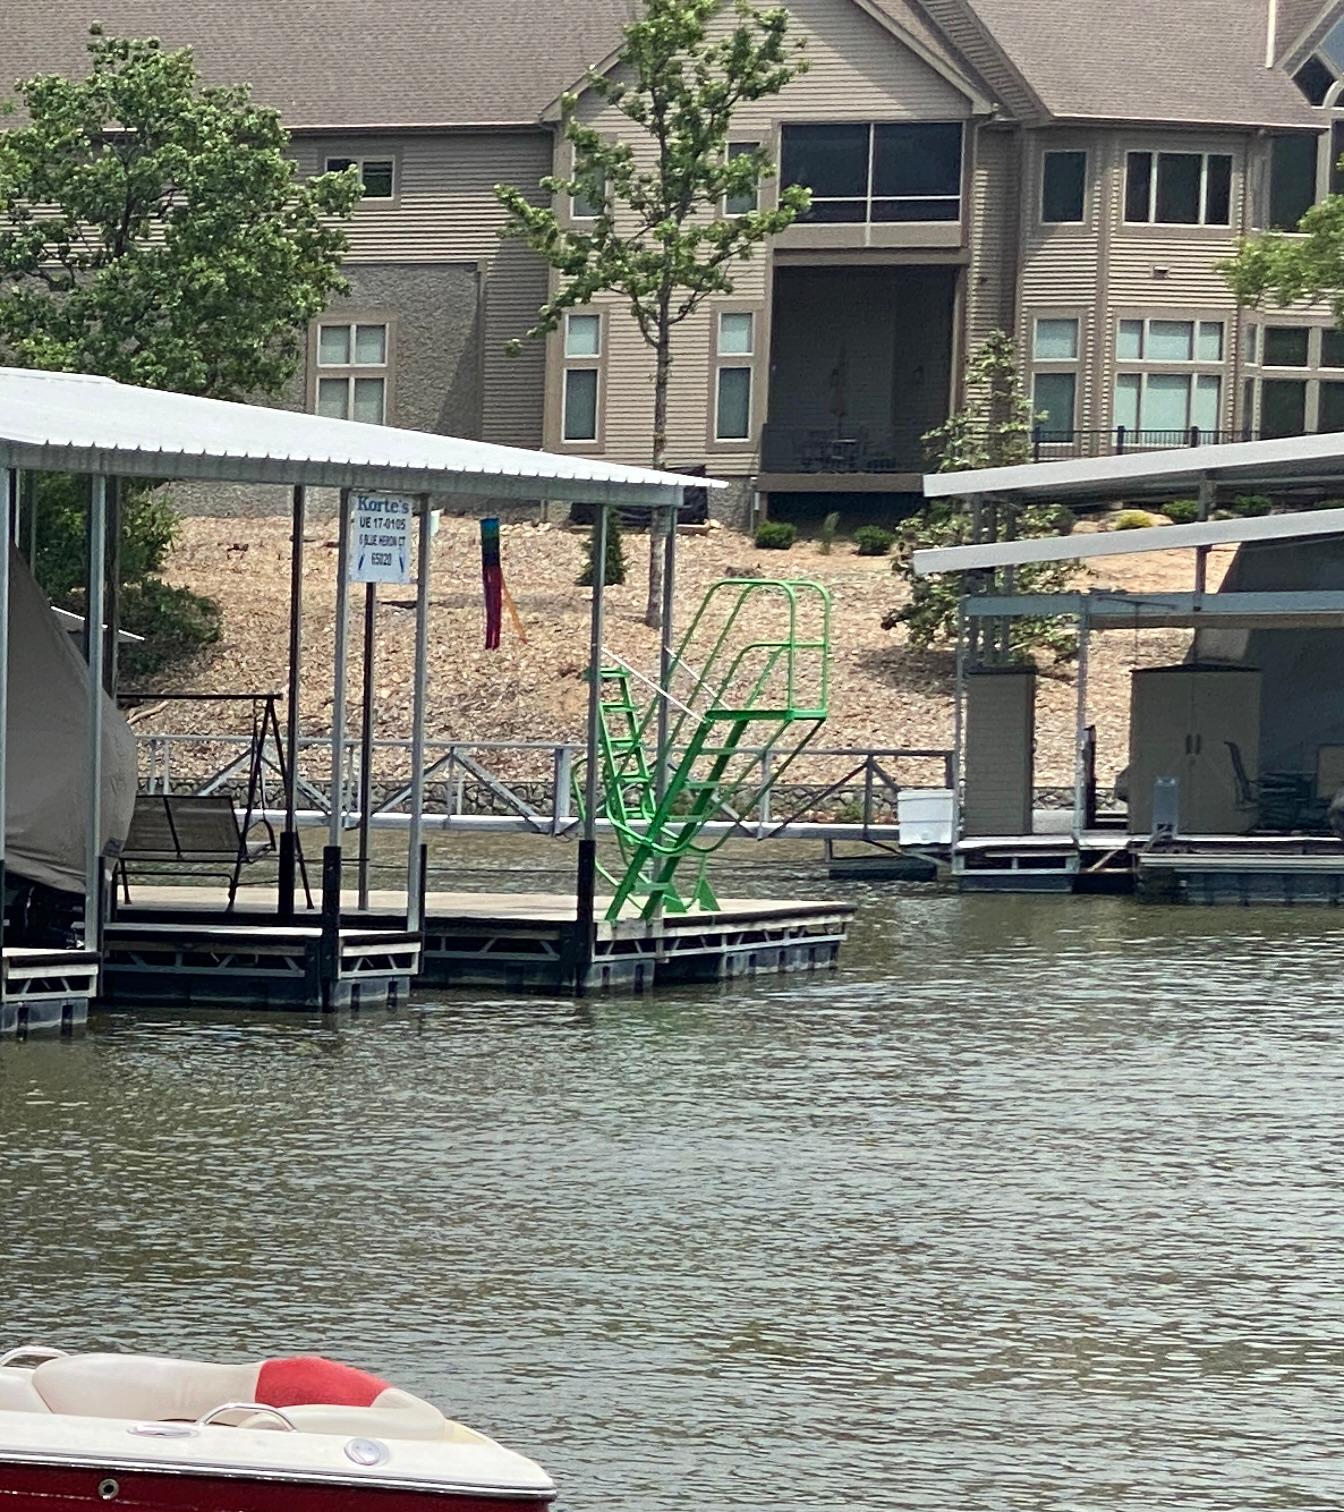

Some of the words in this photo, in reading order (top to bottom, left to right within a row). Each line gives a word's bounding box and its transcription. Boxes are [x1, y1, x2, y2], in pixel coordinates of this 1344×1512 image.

[357, 495, 410, 514] Korte's
[359, 517, 371, 529] UE
[374, 518, 406, 530] 17-0105
